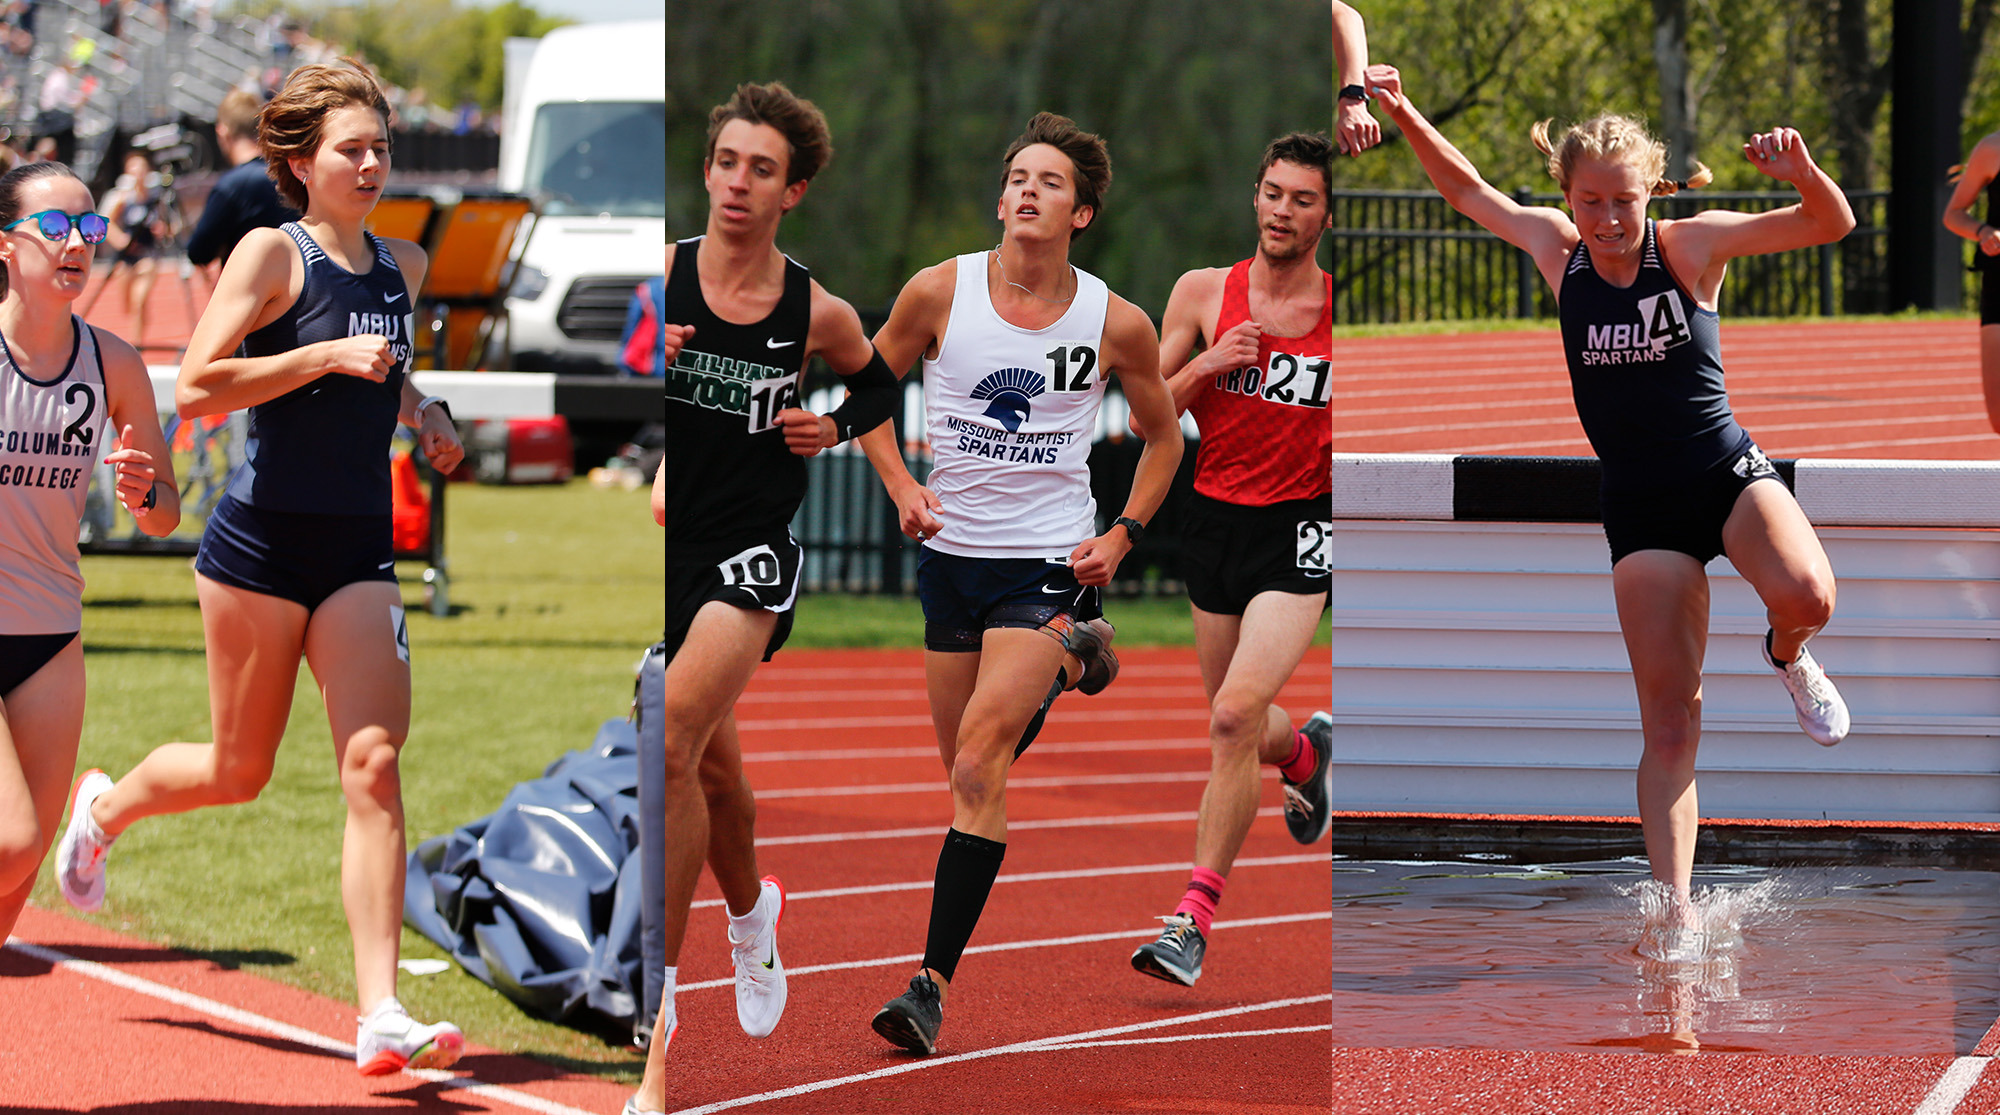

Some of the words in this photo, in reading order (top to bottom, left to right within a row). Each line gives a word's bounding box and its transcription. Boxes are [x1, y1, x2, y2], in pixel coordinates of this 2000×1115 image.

[348, 311, 399, 341] MBU
[1649, 294, 1689, 348] 4
[1588, 323, 1649, 350] MBU
[1046, 346, 1096, 392] 12
[1582, 349, 1666, 366] SPARTANS
[1265, 353, 1331, 408] 21
[63, 383, 95, 445] 2
[751, 381, 795, 431] 16
[947, 416, 1010, 443] MISSOURI
[1016, 432, 1074, 445] BAPTIST
[957, 435, 1058, 464] SPARTANS
[0, 464, 82, 489] COLLEGE
